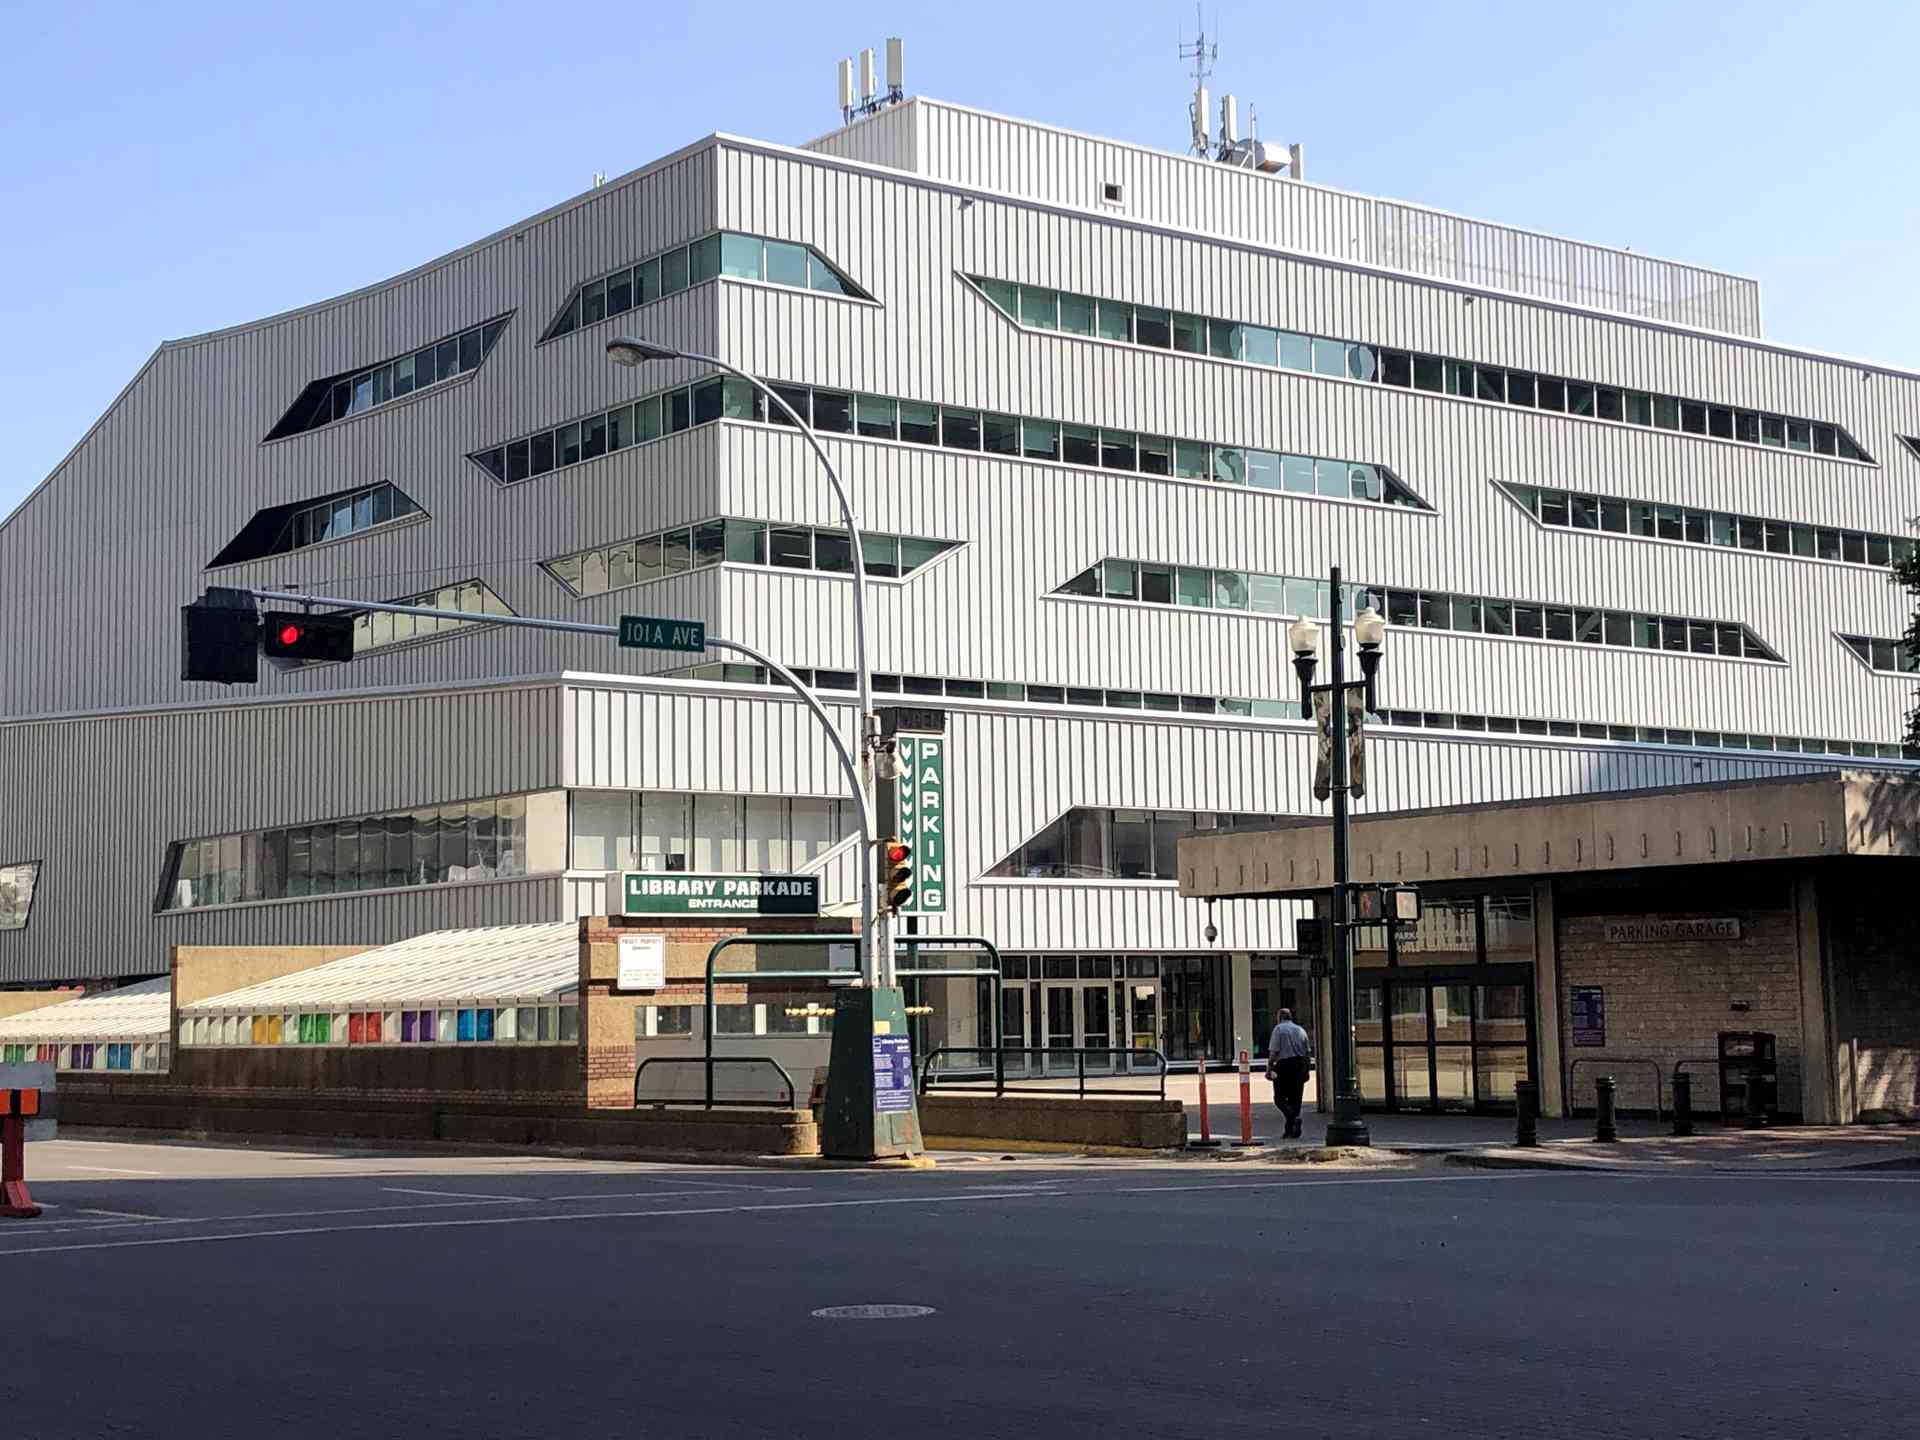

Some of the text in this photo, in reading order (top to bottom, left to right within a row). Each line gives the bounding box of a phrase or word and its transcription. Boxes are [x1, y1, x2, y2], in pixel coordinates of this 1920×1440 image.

[626, 623, 700, 647] 101A AVE
[921, 742, 943, 908] PARKING
[629, 879, 813, 897] LIBRARY PARKADE
[688, 898, 759, 909] ENTRANCE
[1610, 921, 1736, 940] PARKING GARAGE
